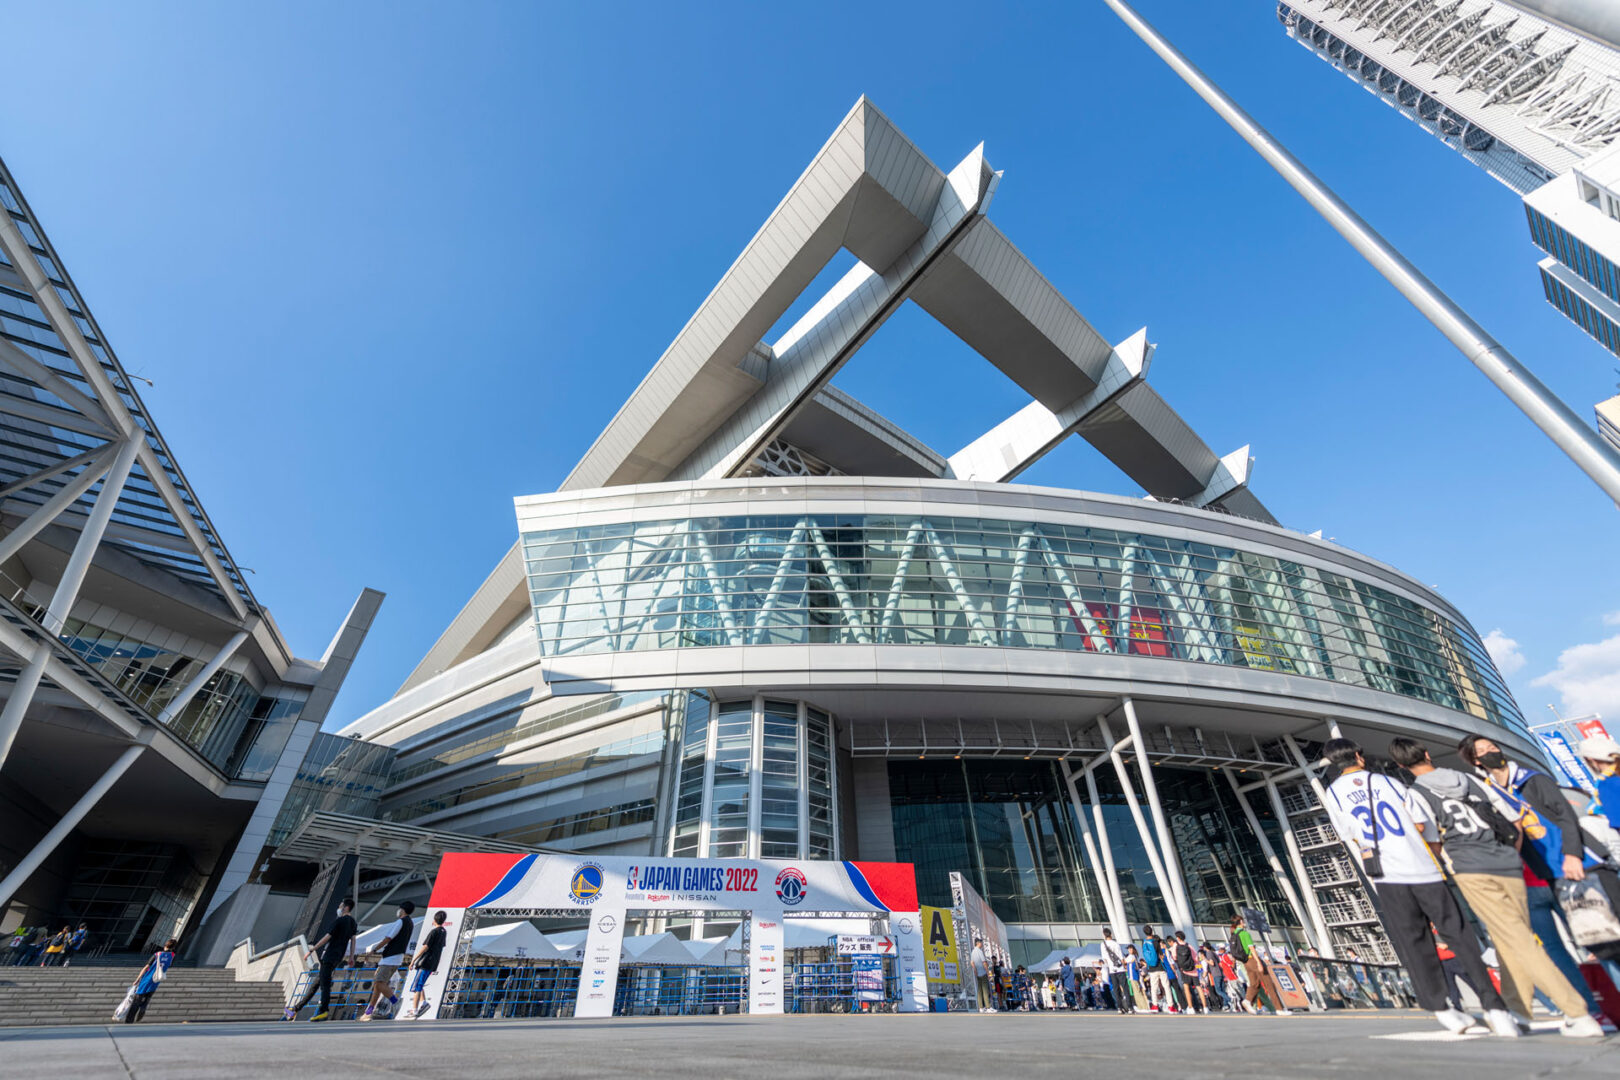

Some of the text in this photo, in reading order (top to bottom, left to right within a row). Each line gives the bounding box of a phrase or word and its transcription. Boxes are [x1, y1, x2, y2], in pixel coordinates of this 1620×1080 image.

[1351, 801, 1405, 841] 30
[639, 866, 759, 892] JAPAN GAMES 2022
[568, 892, 603, 905] WARRIORS
[647, 894, 670, 902] Rakuten
[929, 911, 950, 947] A
[839, 943, 873, 951] グッズ 販売
[933, 947, 949, 957] ゲート
